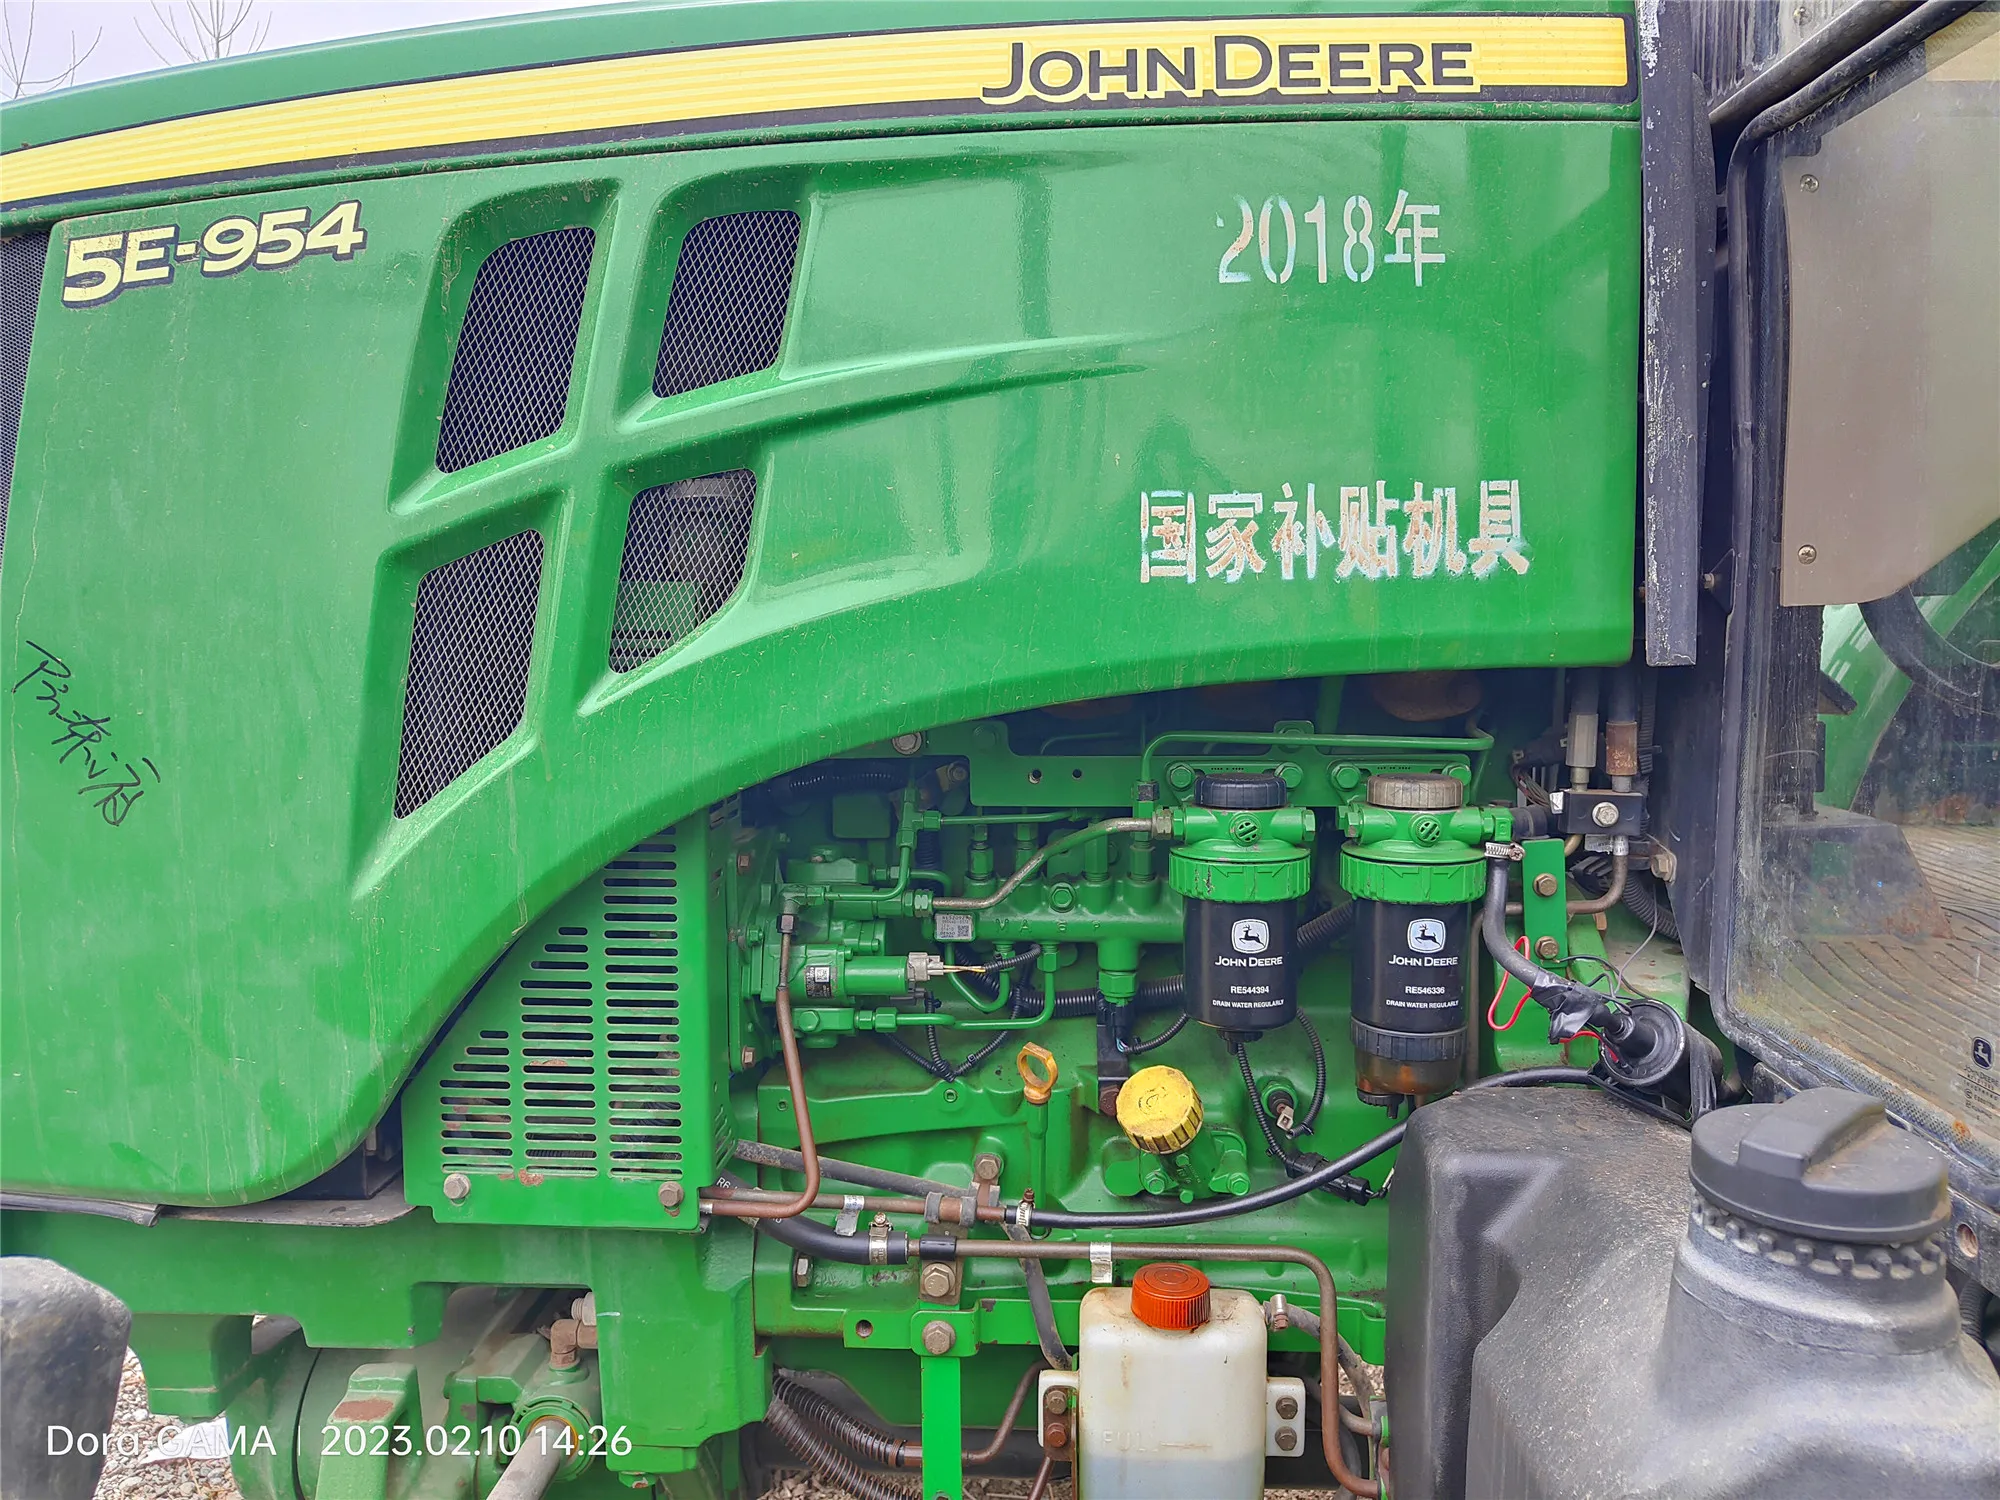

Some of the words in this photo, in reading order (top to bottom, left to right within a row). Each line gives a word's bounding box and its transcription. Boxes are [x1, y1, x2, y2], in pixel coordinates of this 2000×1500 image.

[981, 42, 1196, 98] JOHN
[1214, 35, 1474, 91] DEERE
[1214, 189, 1446, 287] 2018年
[61, 200, 367, 309] 5E-954
[1139, 479, 1530, 584] 国家补贴机具
[1215, 955, 1247, 967] JOHN
[1248, 956, 1283, 967] DEERE
[1388, 954, 1422, 967] JOHN
[1424, 956, 1459, 967] DEERE
[1230, 985, 1270, 994] RE544394
[1404, 985, 1446, 995] RE546336
[1212, 999, 1231, 1008] DRAIN
[1231, 1001, 1253, 1009] WATER
[1253, 999, 1285, 1009] REGULARLY
[1386, 999, 1406, 1008] DRAIN
[1406, 1001, 1429, 1009] WATER
[1429, 999, 1460, 1009] REGULARLY
